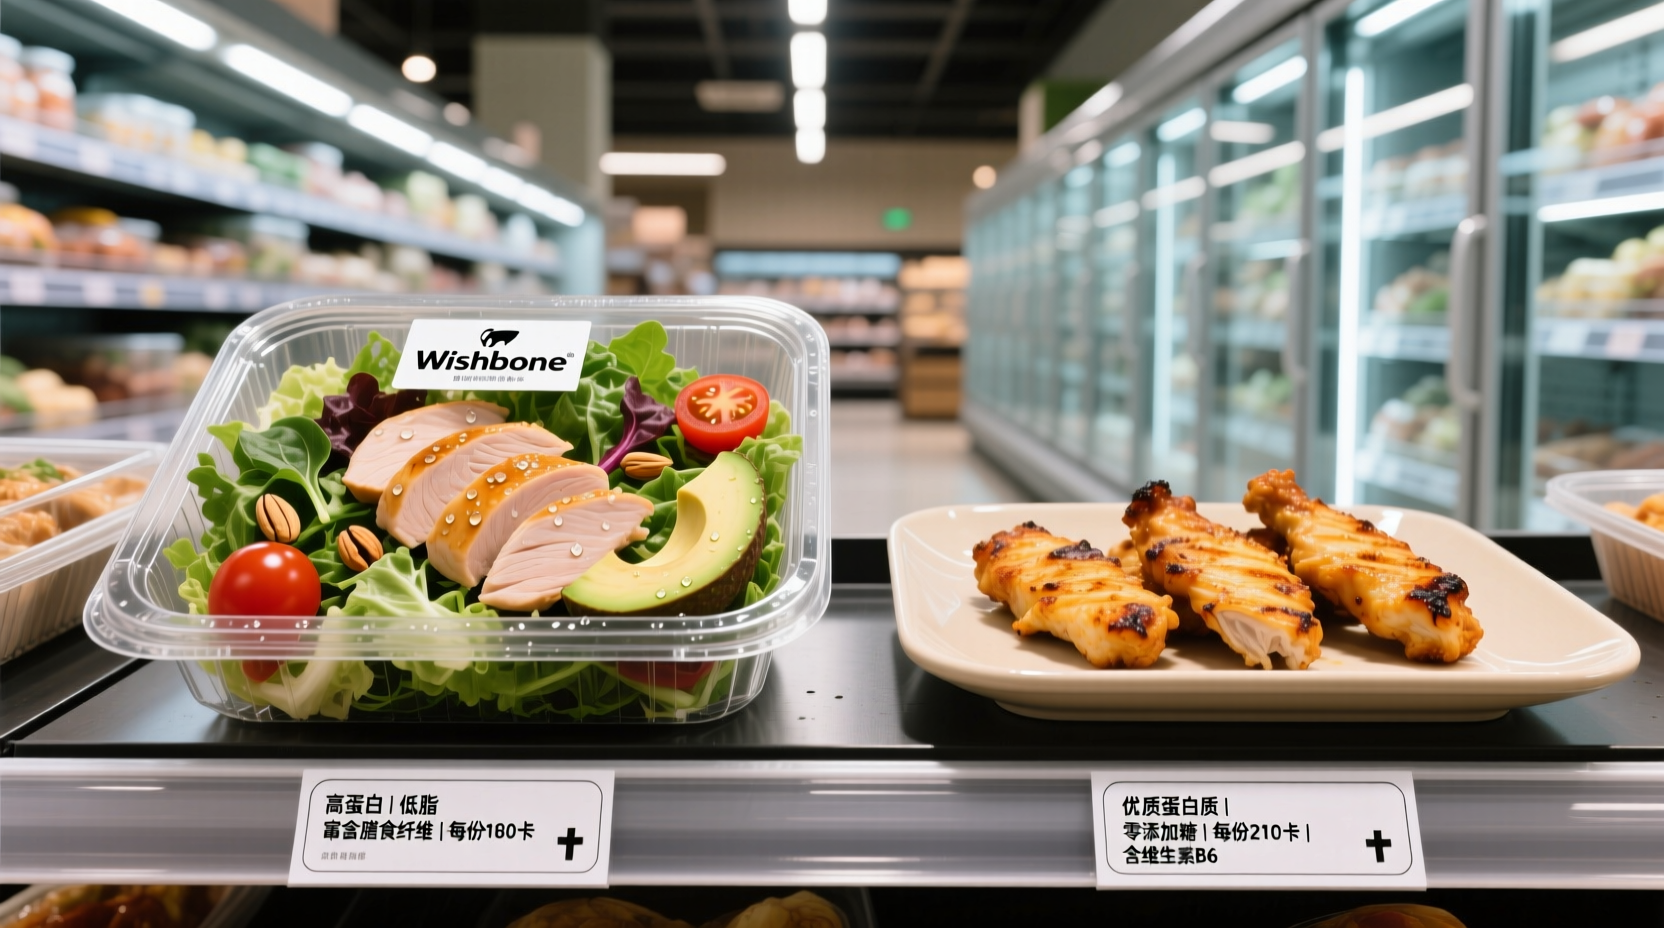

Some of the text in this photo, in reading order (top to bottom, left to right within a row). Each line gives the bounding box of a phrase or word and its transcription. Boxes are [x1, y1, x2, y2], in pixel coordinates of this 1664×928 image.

[417, 350, 568, 371] Wishbone
[325, 793, 383, 815] 高蛋白
[399, 793, 440, 816] 低脂
[1121, 795, 1219, 817] 优质蛋白质
[448, 820, 536, 842] 每份180卡
[1122, 820, 1198, 842] 零添加糖
[1212, 821, 1300, 843] 每份210卡
